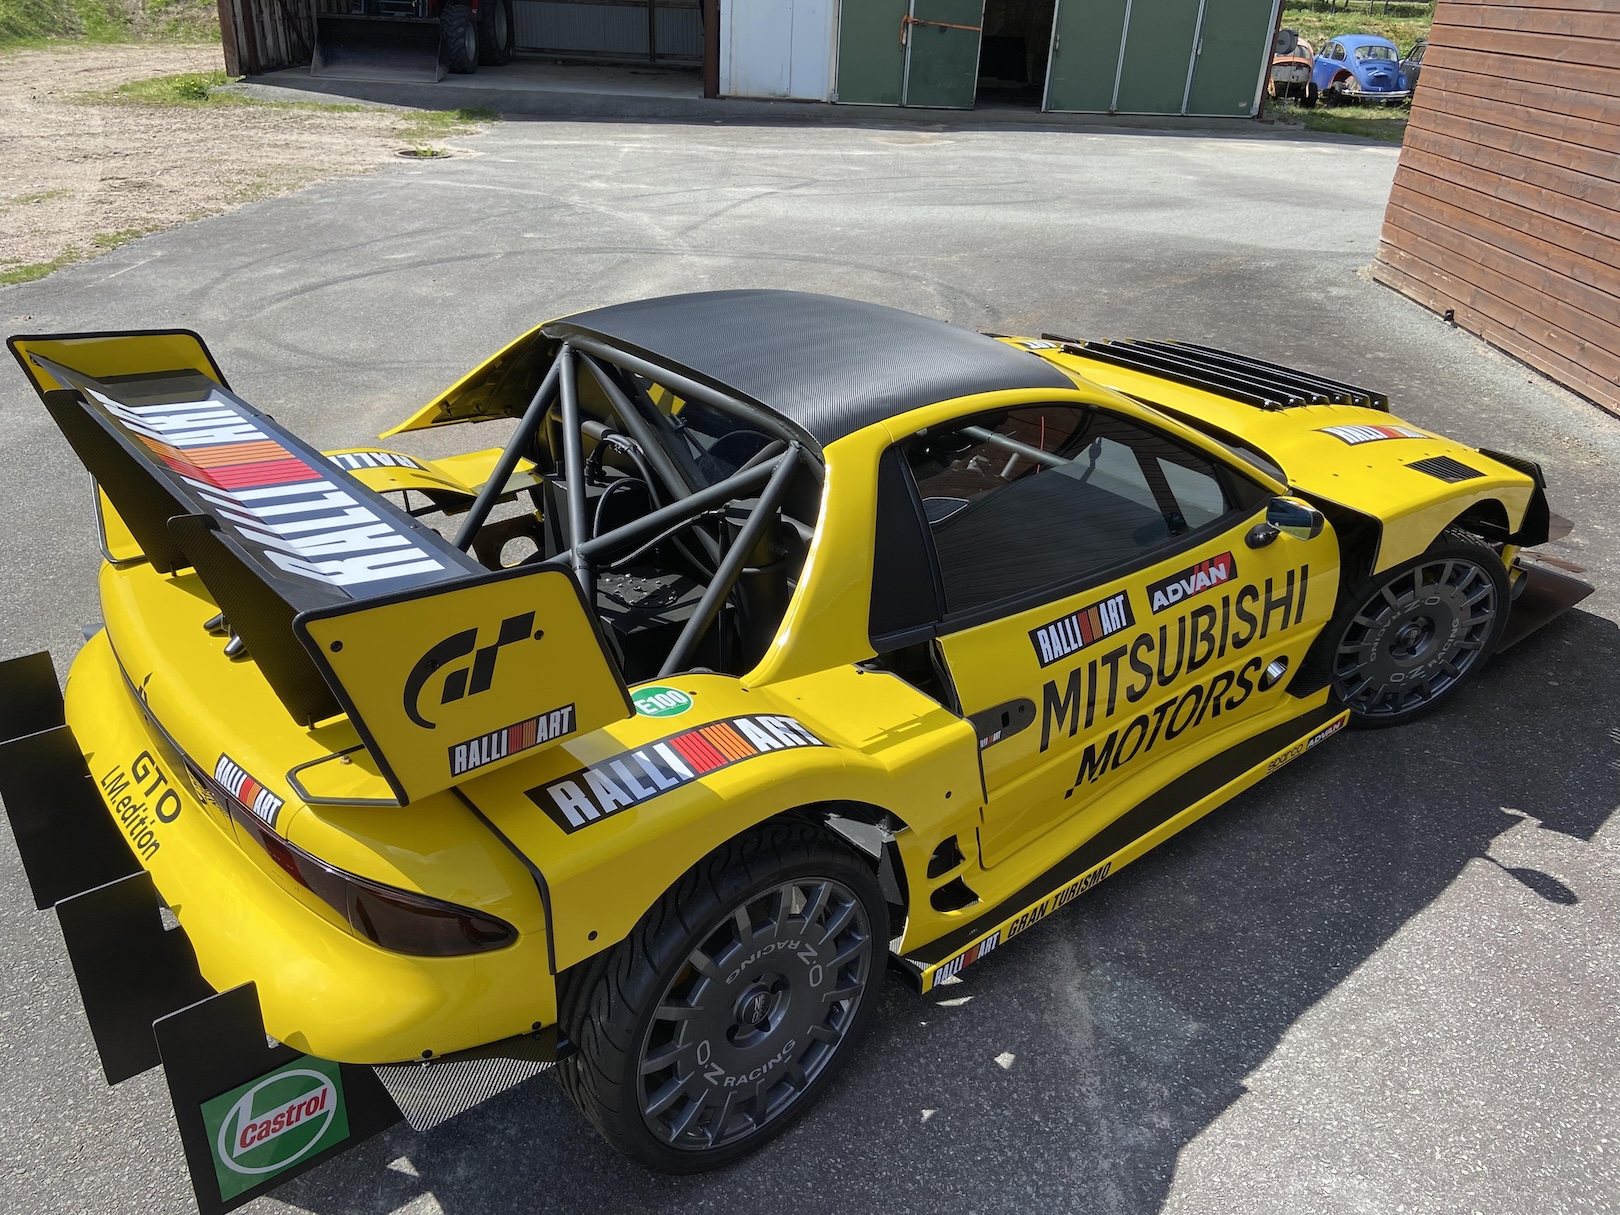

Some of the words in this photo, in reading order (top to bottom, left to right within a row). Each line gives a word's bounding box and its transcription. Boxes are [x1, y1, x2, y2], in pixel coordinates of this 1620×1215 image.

[85, 387, 270, 449] ART
[180, 475, 446, 586] RALLI
[1153, 563, 1228, 611] ADVAN
[1037, 615, 1083, 664] RALLI
[1100, 594, 1127, 635] ART
[1040, 564, 1309, 753] MITSUBISHI
[634, 690, 688, 714] E100
[1064, 655, 1262, 800] MOTORS
[1307, 721, 1340, 748] ADVAN
[454, 729, 508, 775] RALLI
[536, 705, 572, 744] ART
[546, 742, 695, 828] RALLI
[733, 716, 823, 752] ART
[1268, 743, 1304, 773] sparco
[131, 750, 181, 823] GTO
[214, 756, 247, 798] RALLI
[253, 788, 282, 824] ART
[1008, 900, 1049, 938] GRAN
[1052, 861, 1112, 910] TURISMO
[726, 939, 801, 984] RACING
[934, 954, 965, 987] RALLI
[978, 932, 999, 959] ART
[723, 1039, 796, 1087] RACING
[240, 1088, 328, 1149] Castrol
